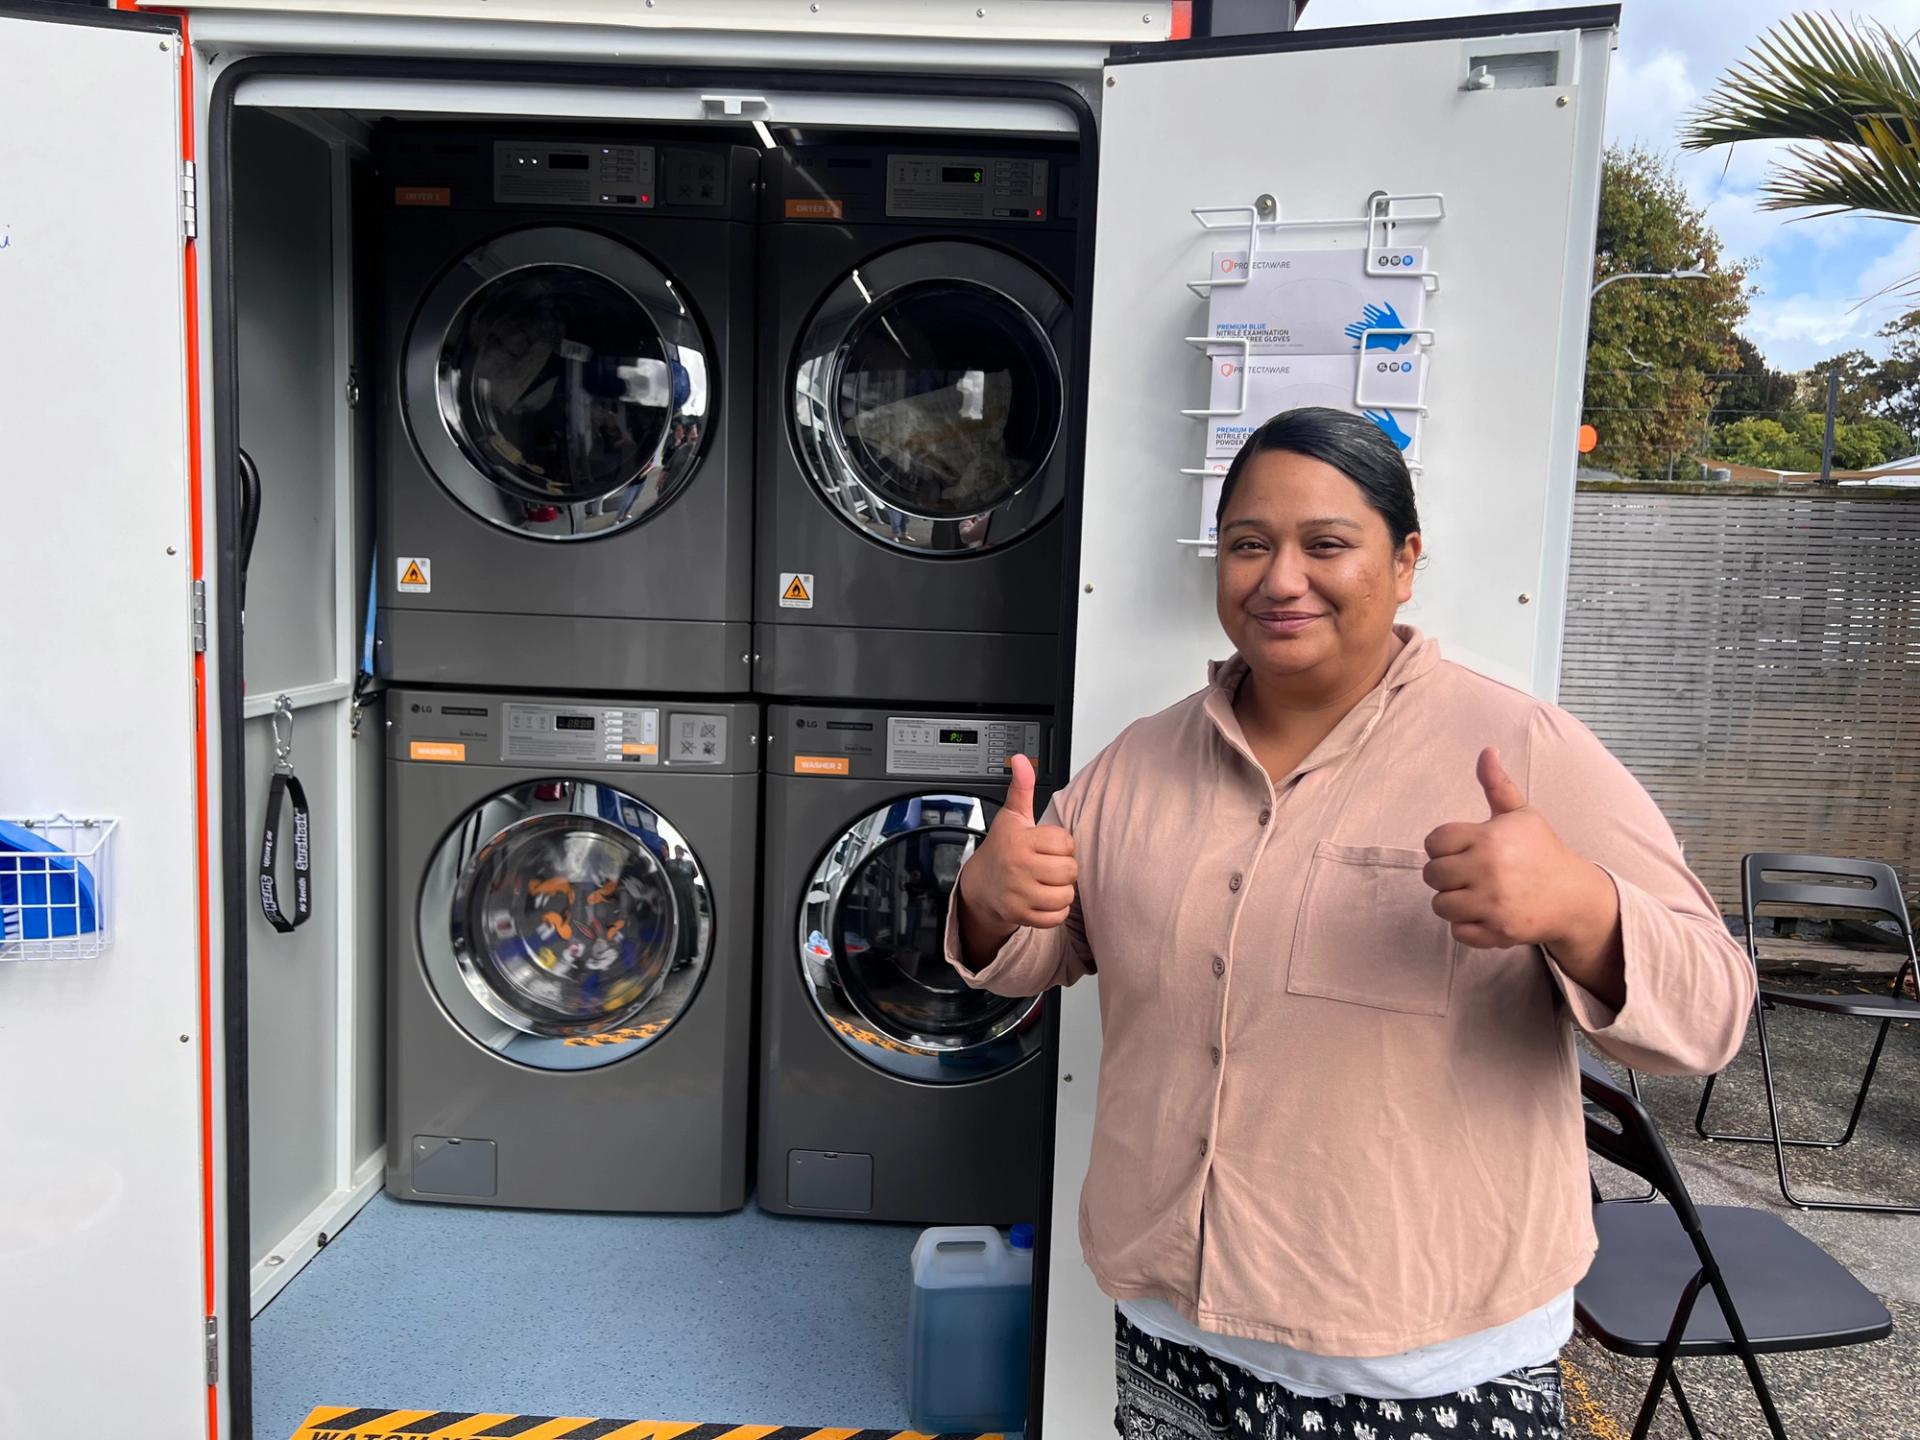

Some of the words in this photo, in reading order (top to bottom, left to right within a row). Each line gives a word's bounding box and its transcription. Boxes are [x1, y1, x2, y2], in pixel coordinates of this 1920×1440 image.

[1233, 261, 1291, 270] PROECTAWARE
[1233, 366, 1291, 375] PRTECTAWARE
[800, 761, 836, 769] WASHER
[295, 812, 309, 870] SureHook
